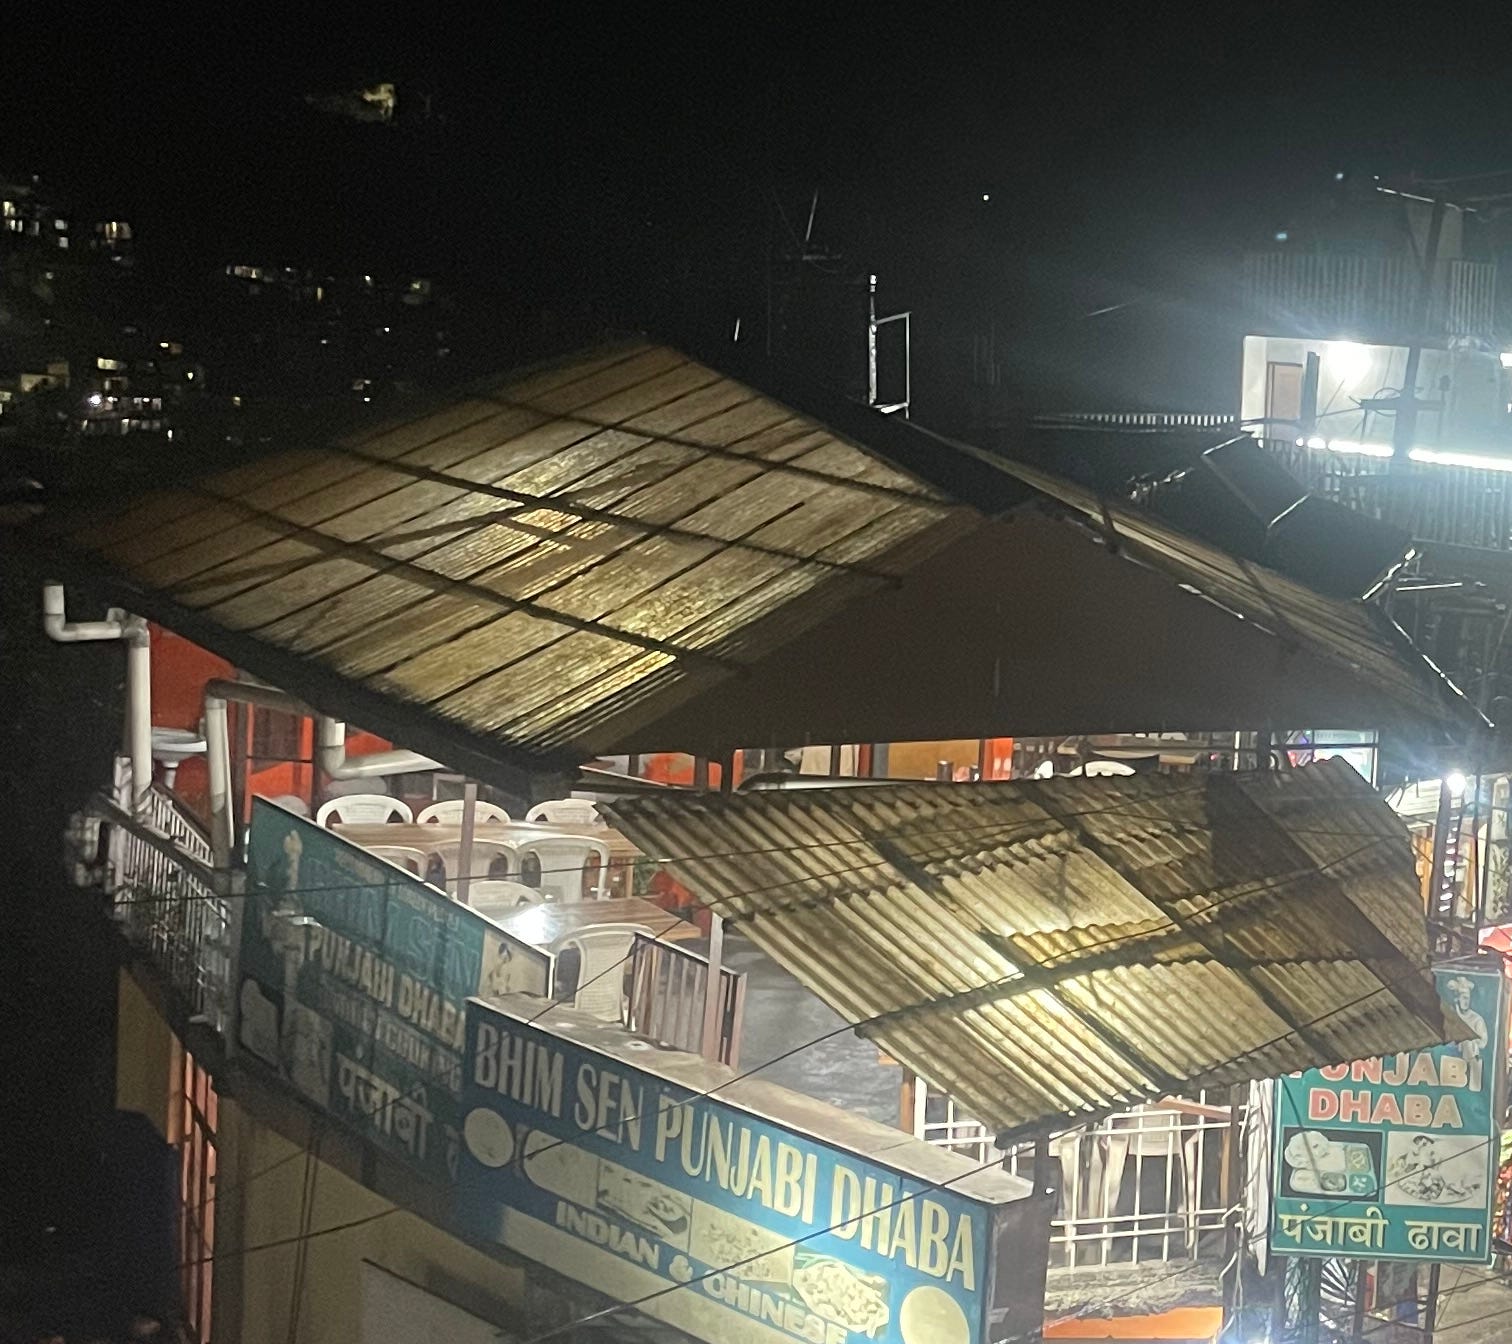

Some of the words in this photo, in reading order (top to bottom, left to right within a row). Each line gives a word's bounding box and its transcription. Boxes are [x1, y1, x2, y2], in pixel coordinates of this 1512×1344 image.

[1289, 1051, 1483, 1093] UNJABI
[1308, 1087, 1464, 1129] DHABA
[474, 1021, 564, 1118] BHIM
[573, 1062, 644, 1152] SEN
[655, 1093, 818, 1226] PUNJABI
[829, 1163, 976, 1292] DHABA
[555, 1200, 660, 1271] INDIAN
[668, 1254, 694, 1284] &
[1278, 1202, 1390, 1249] पंजाबी
